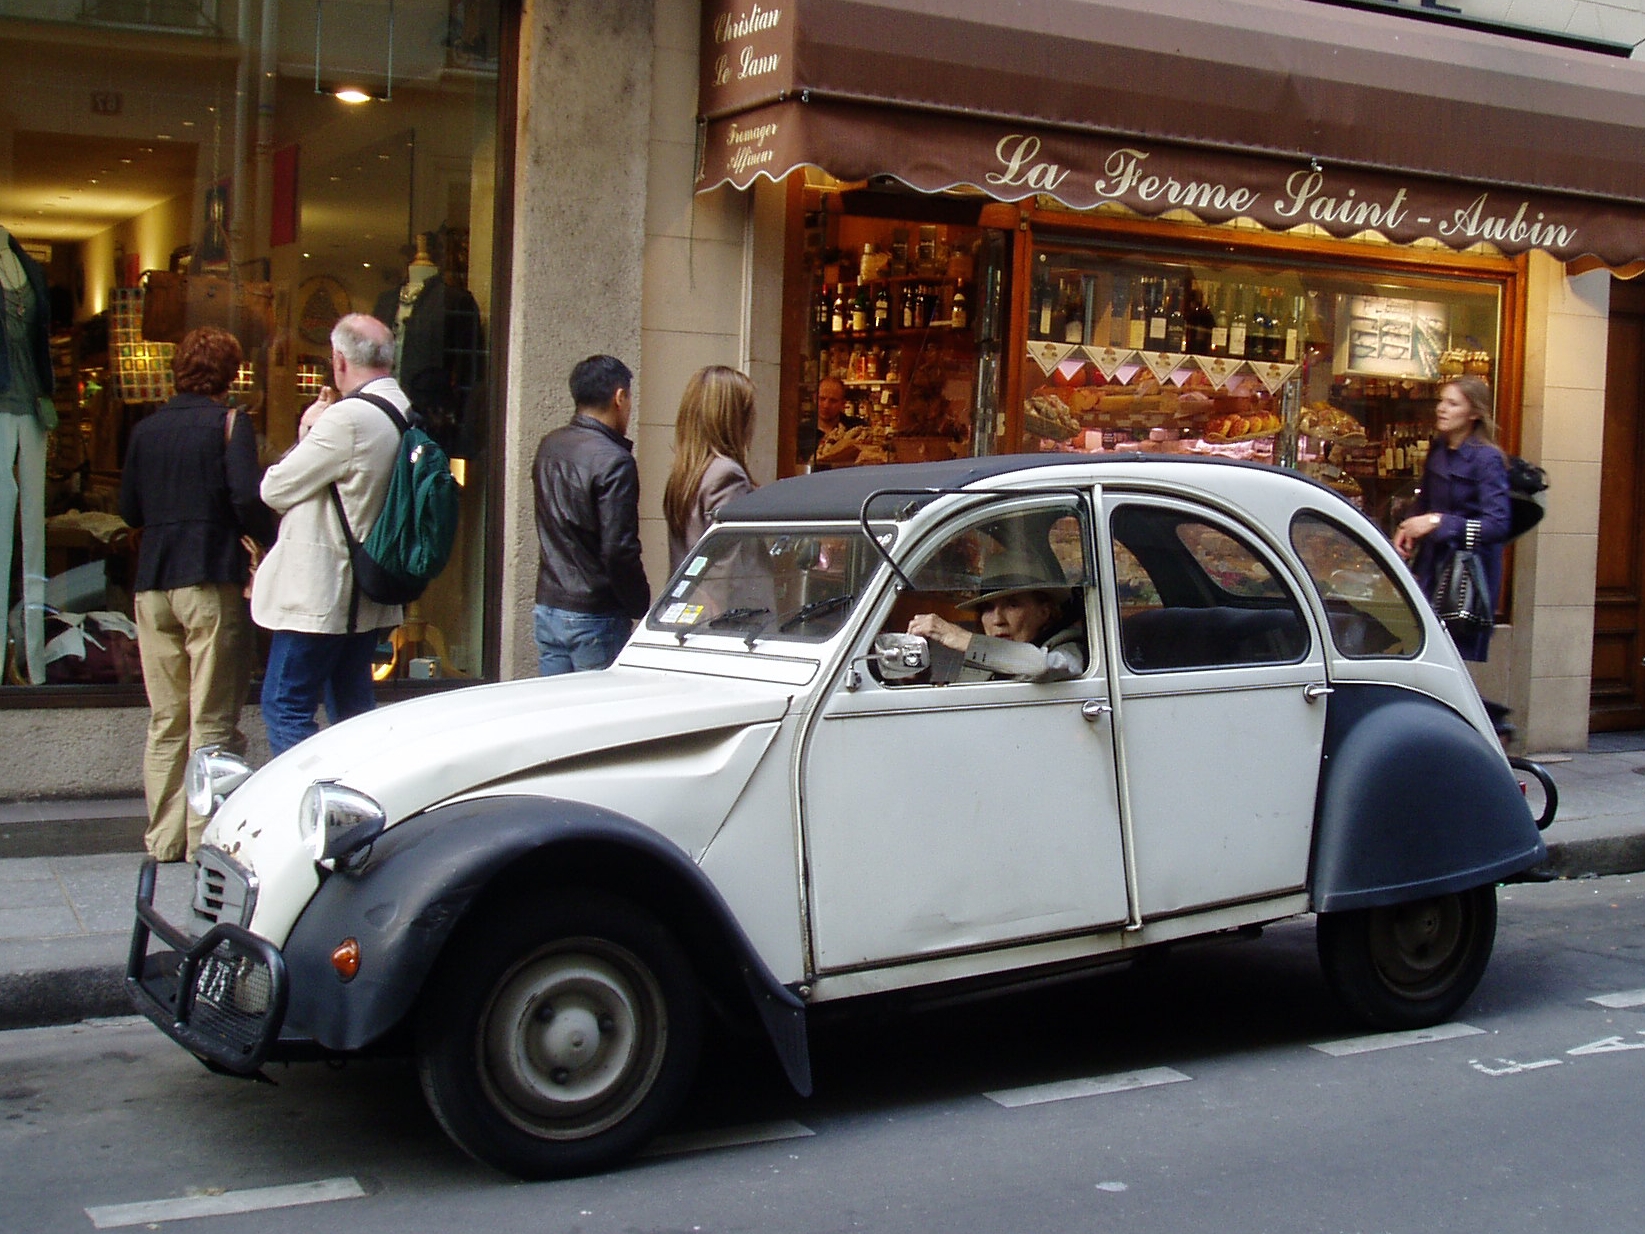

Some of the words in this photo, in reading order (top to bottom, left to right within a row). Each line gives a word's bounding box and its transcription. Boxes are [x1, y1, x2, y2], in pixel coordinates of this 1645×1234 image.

[714, 3, 782, 43] Christian
[712, 54, 732, 86] Le
[737, 45, 781, 80] Lann
[726, 123, 778, 148] Fromager
[727, 146, 774, 174] Affineur
[985, 134, 1070, 190] La
[1095, 148, 1260, 212] Ferme
[1274, 169, 1408, 228] Saint
[1438, 192, 1578, 247] Aubin
